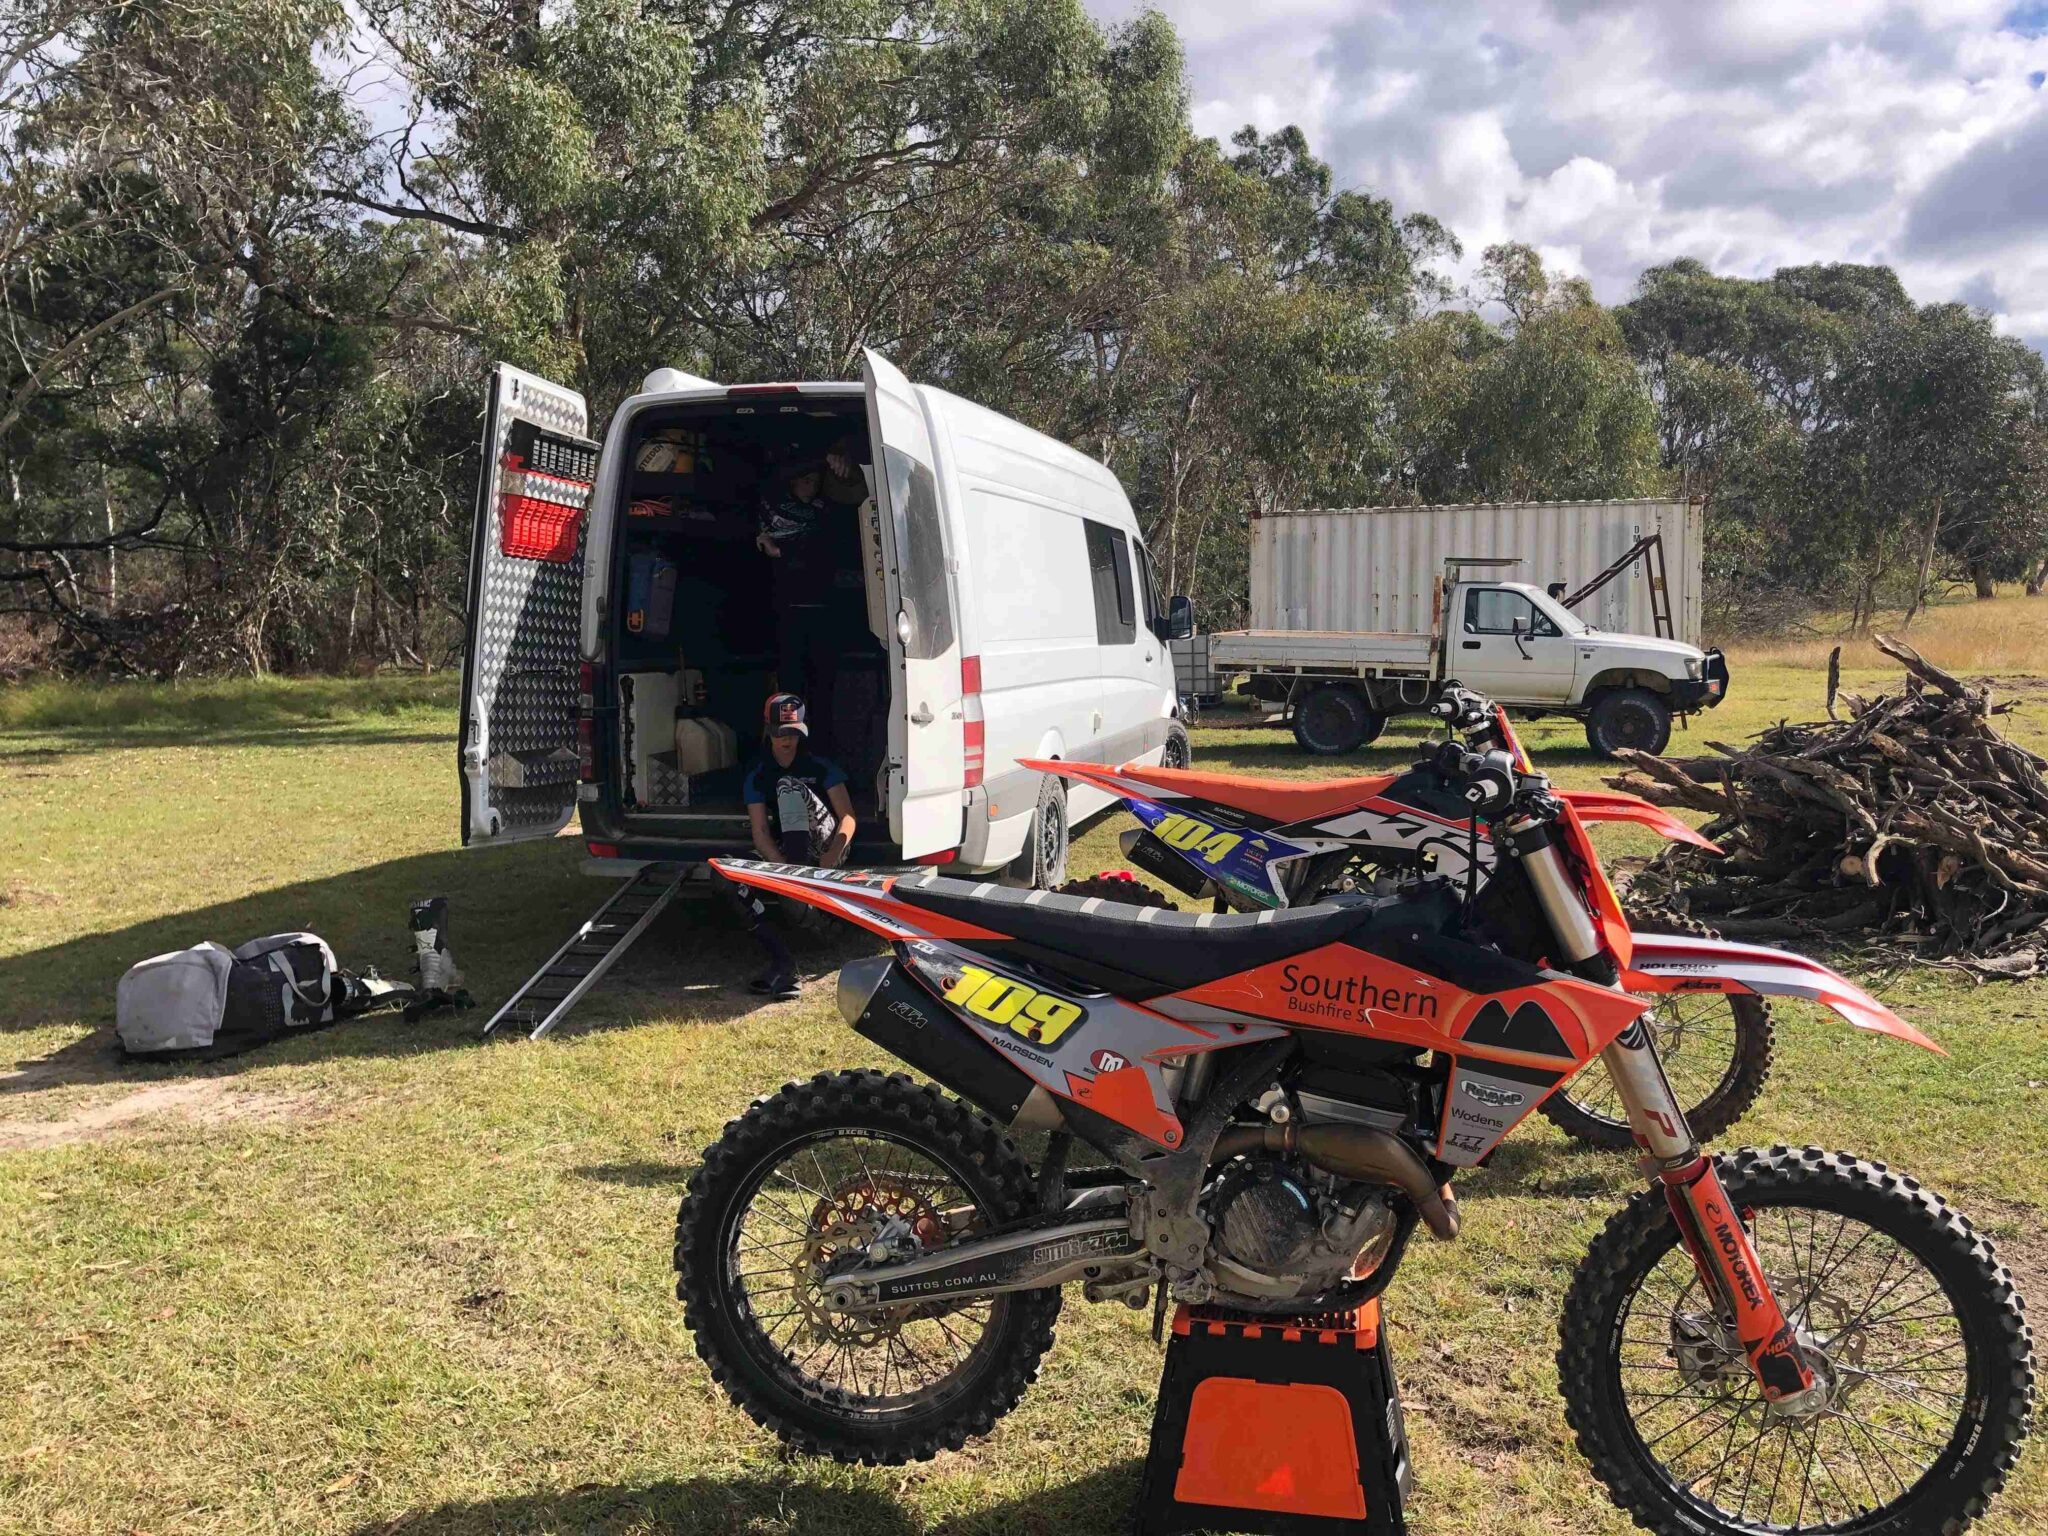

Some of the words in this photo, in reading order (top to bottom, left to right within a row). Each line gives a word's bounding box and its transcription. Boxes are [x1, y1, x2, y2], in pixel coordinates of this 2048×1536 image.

[1152, 812, 1244, 864] 104
[1236, 880, 1270, 900] MOTOREX
[943, 964, 1083, 1045] 109
[1280, 964, 1438, 1018] Southern
[888, 1001, 928, 1029] KTM
[1288, 996, 1352, 1020] Bushfire
[992, 1036, 1054, 1069] MARSDEN
[1451, 1106, 1504, 1128] Wodens
[1715, 1223, 1764, 1311] MOTOREX
[891, 1272, 997, 1295] SUTTOS.COM.AU
[1614, 1293, 1632, 1326] EXCEL
[1962, 1424, 1983, 1456] EXCEL
